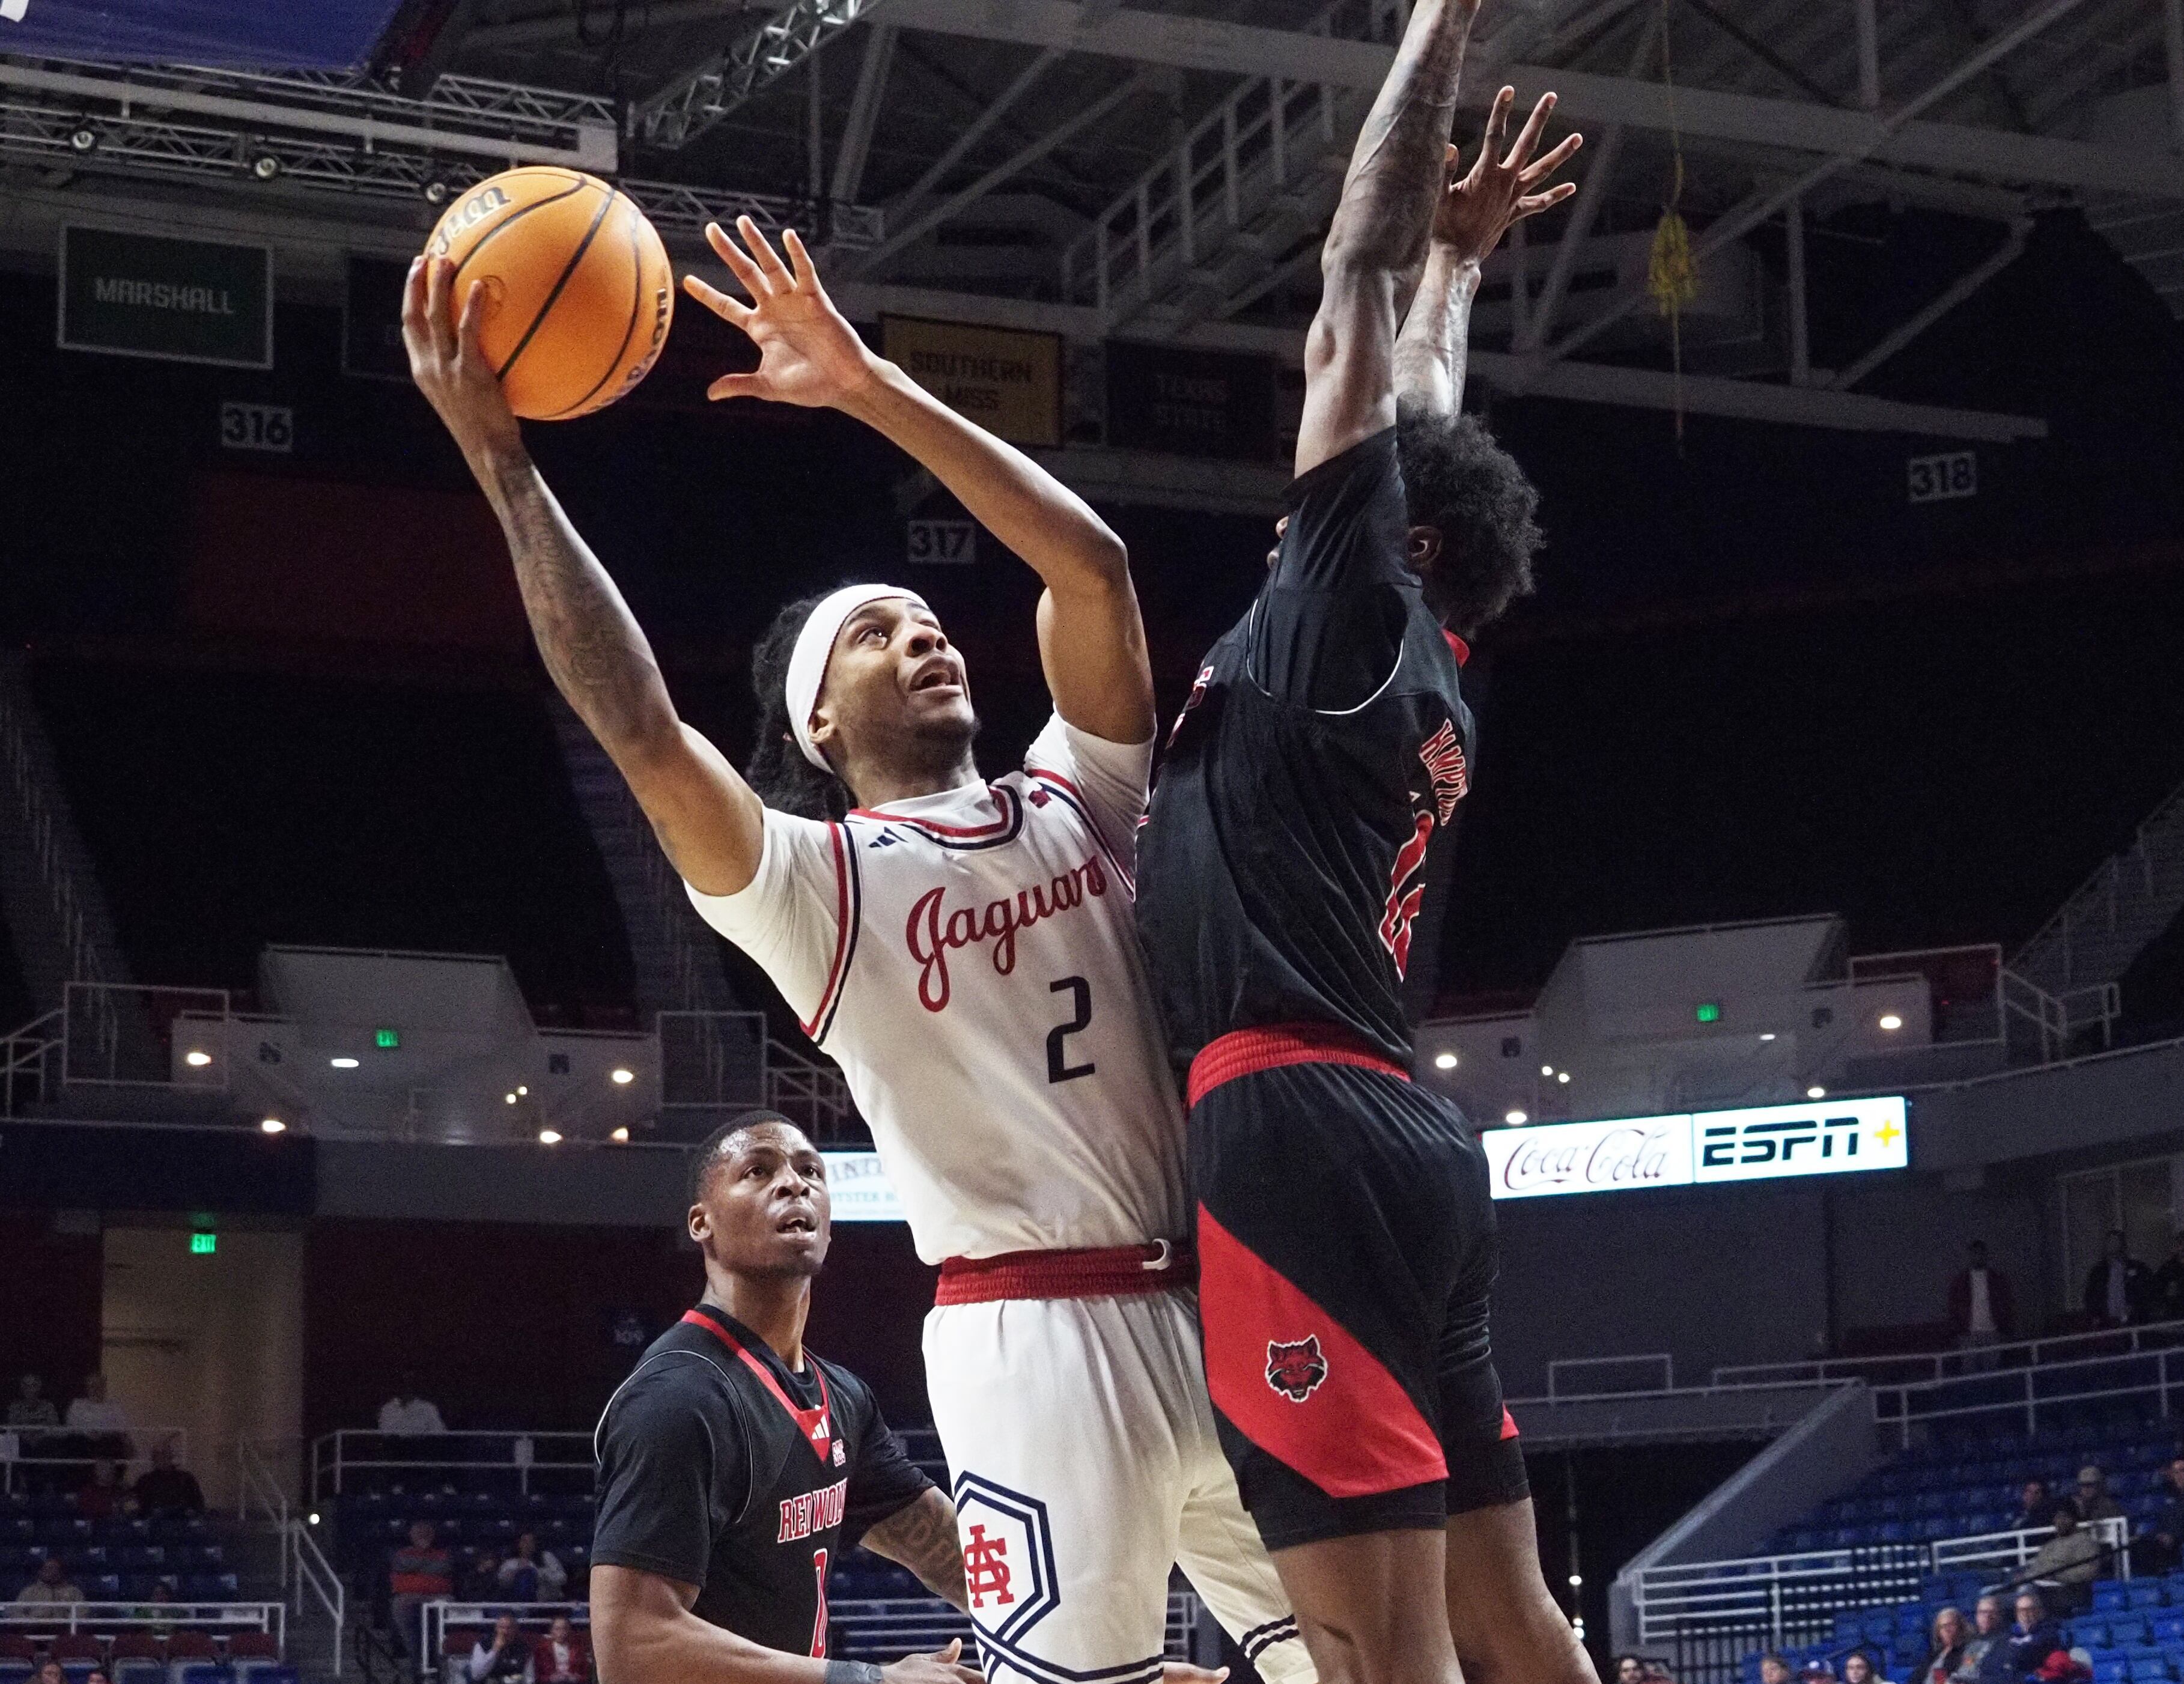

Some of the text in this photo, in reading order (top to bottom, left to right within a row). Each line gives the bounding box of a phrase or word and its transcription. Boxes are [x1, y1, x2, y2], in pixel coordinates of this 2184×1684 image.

[94, 276, 234, 315] MARSHALL
[909, 351, 1032, 383] SOUTHERN
[943, 383, 1000, 410] MISS
[224, 407, 290, 446] 316
[1912, 457, 1973, 496] 318
[910, 525, 972, 558] 317
[1045, 975, 1096, 1084] 2
